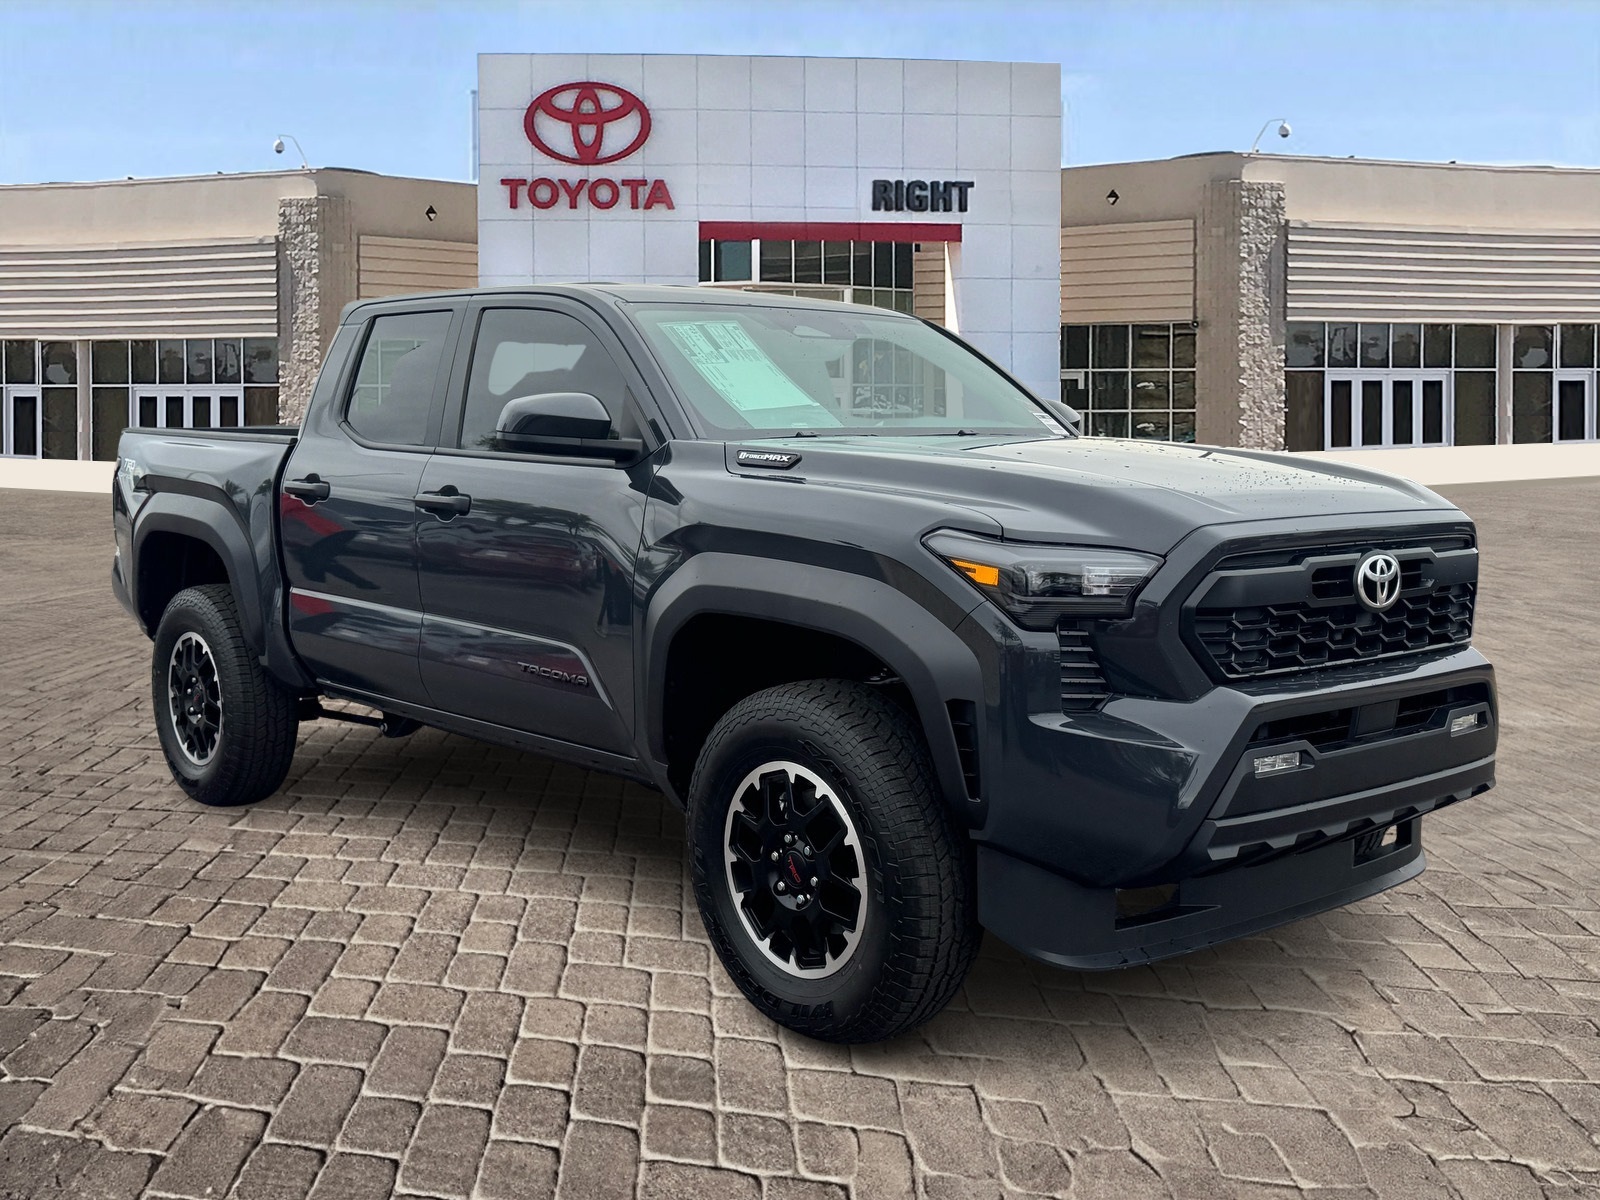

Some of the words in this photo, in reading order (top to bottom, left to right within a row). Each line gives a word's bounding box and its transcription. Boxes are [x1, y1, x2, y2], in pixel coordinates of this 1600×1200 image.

[500, 178, 675, 210] TOYOTA
[872, 180, 975, 212] RIGHT
[517, 661, 588, 686] TACOMA
[788, 855, 801, 883] TRD
